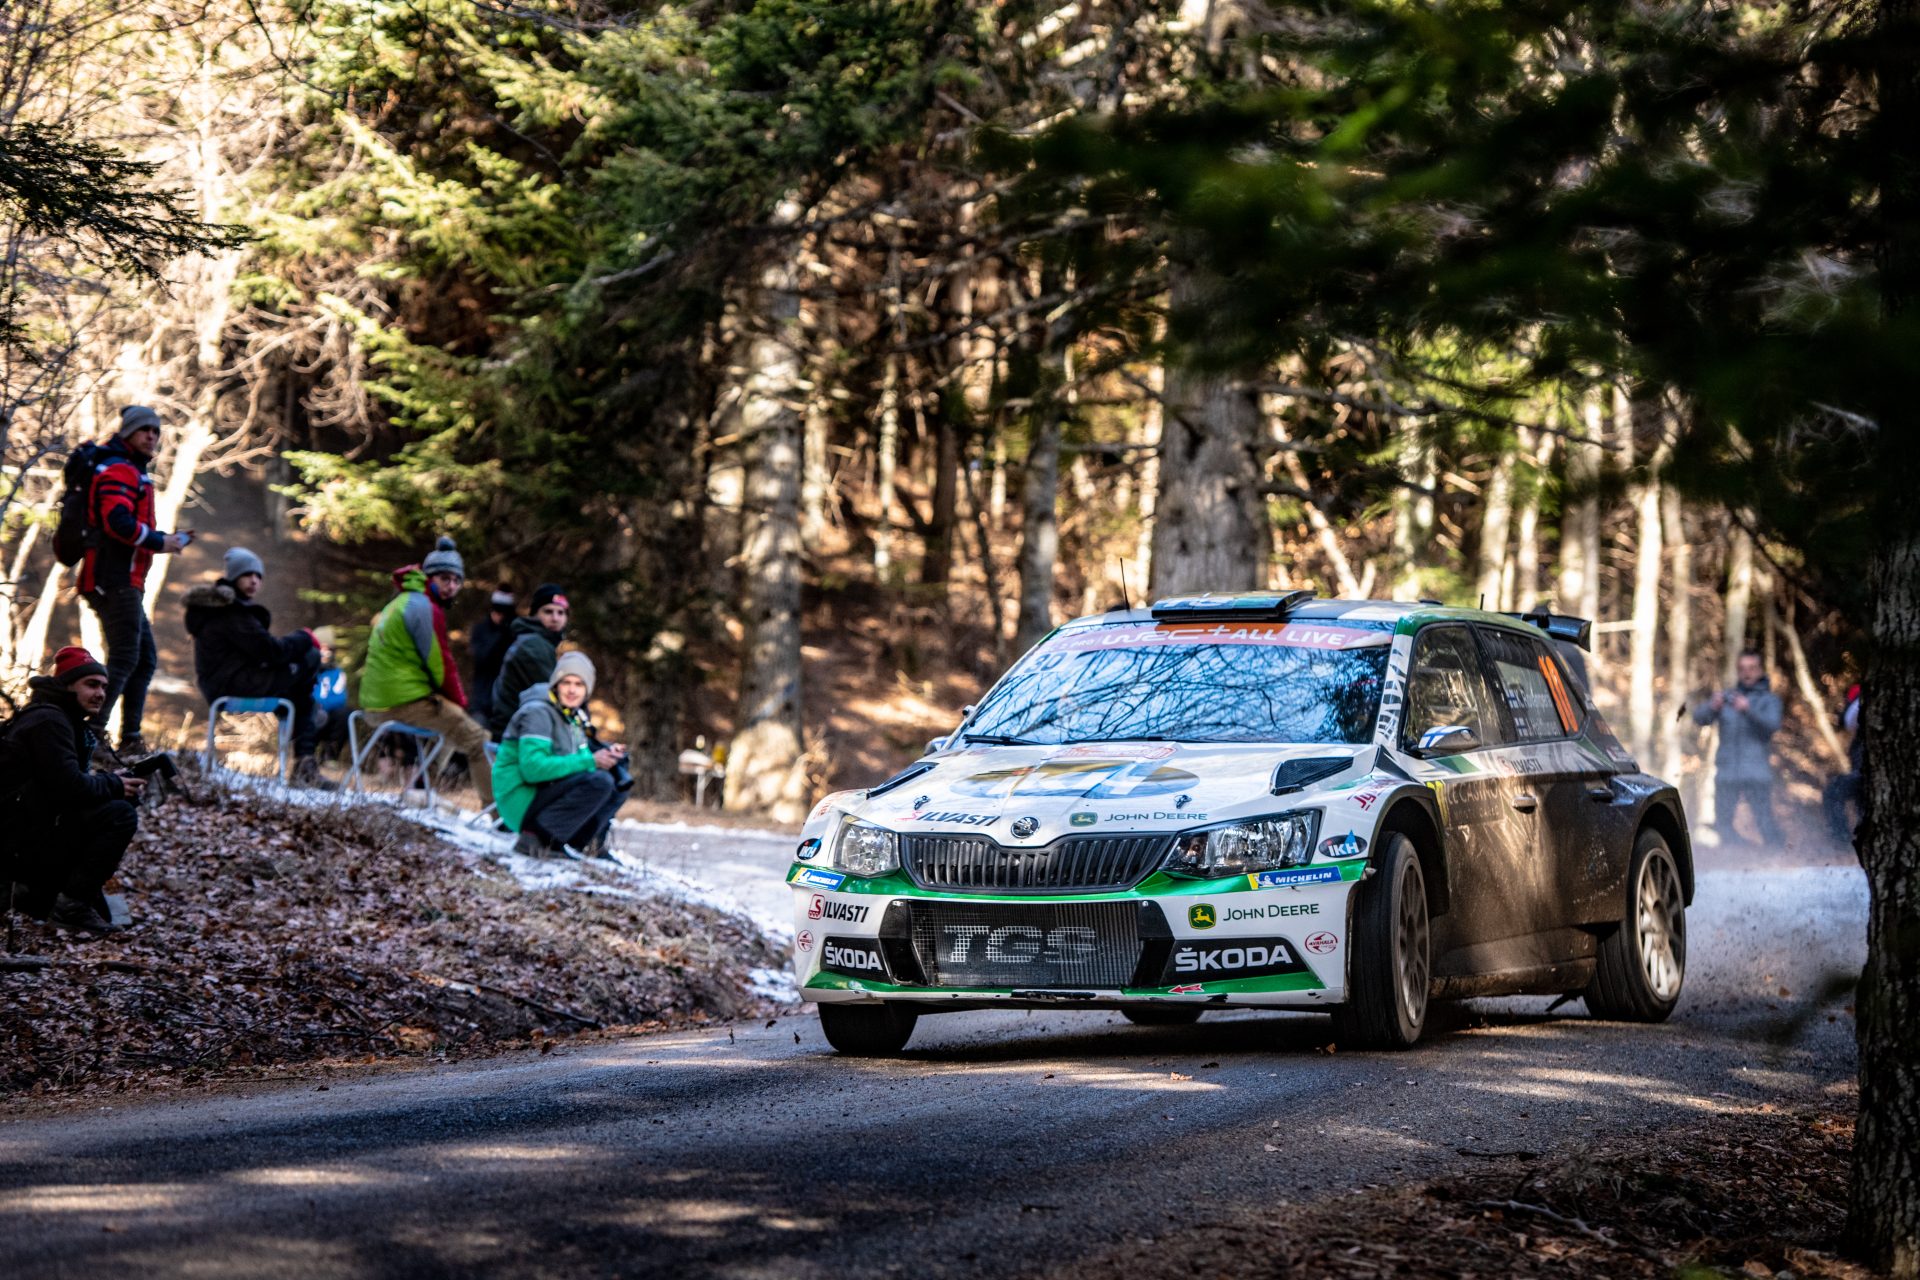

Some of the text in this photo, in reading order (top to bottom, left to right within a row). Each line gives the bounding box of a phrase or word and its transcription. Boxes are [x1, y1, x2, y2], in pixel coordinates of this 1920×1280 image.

[1230, 628, 1278, 641] ALL
[1286, 630, 1344, 645] LIVE
[897, 810, 1001, 827] SILVASTI
[1104, 811, 1208, 822] JOHN DEERE
[1275, 871, 1332, 884] MICHELIN
[809, 898, 870, 923] SILVASTI
[1223, 903, 1320, 921] JOHN DEERE
[944, 925, 1096, 963] TGS
[824, 941, 884, 971] ŠKODA
[1175, 945, 1293, 973] ŠKODA
